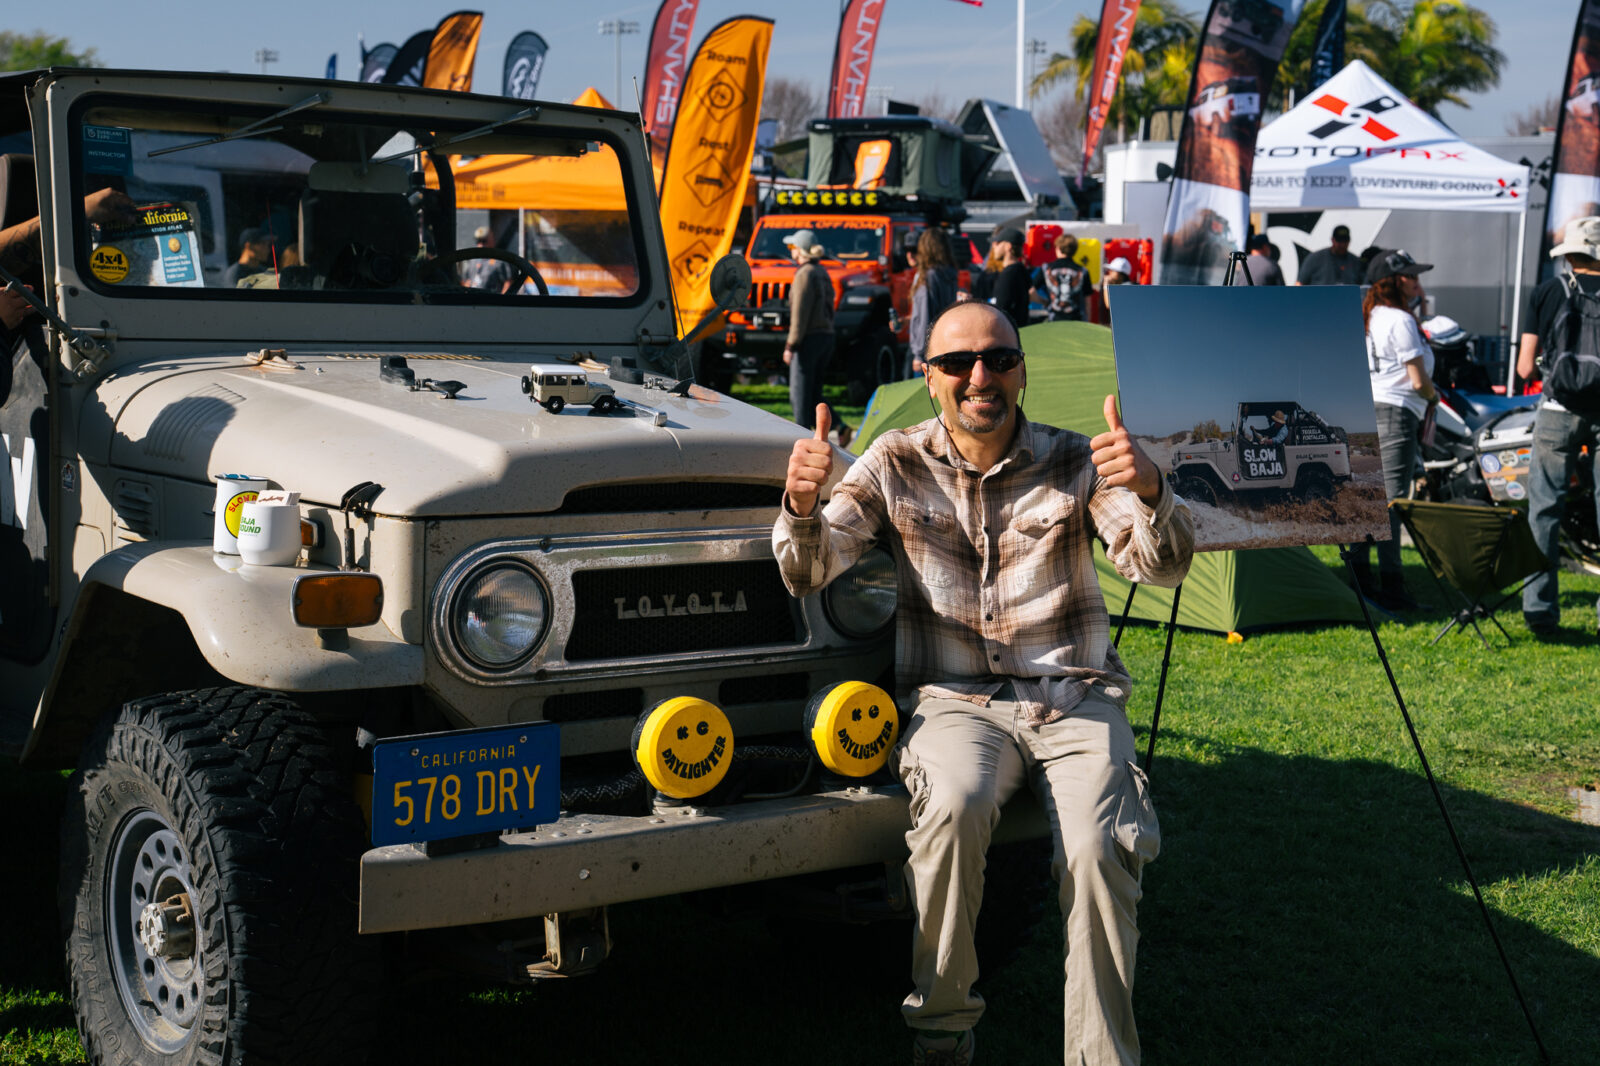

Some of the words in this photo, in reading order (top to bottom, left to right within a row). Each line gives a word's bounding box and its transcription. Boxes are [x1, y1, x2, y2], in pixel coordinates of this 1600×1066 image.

[707, 50, 747, 65] Roam
[699, 136, 729, 151] Rest
[1250, 175, 1284, 188] EAR
[1285, 176, 1308, 188] TO
[1310, 175, 1347, 188] KEEP
[1349, 175, 1438, 190] ADVENTURE
[1440, 180, 1494, 191] GOING
[143, 208, 188, 225] alifornia
[677, 220, 725, 236] Repeat
[95, 252, 123, 265] 4x4
[1243, 448, 1277, 463] SLOW
[1249, 462, 1284, 476] BAJA
[228, 494, 250, 513] SLOW
[614, 590, 747, 620] TOYOTA
[837, 720, 894, 760] DAYLIGHTER
[421, 745, 516, 768] CALIFORNIA
[661, 735, 727, 780] DAYLIGHTER
[394, 774, 461, 826] 578
[476, 765, 541, 815] DRY
